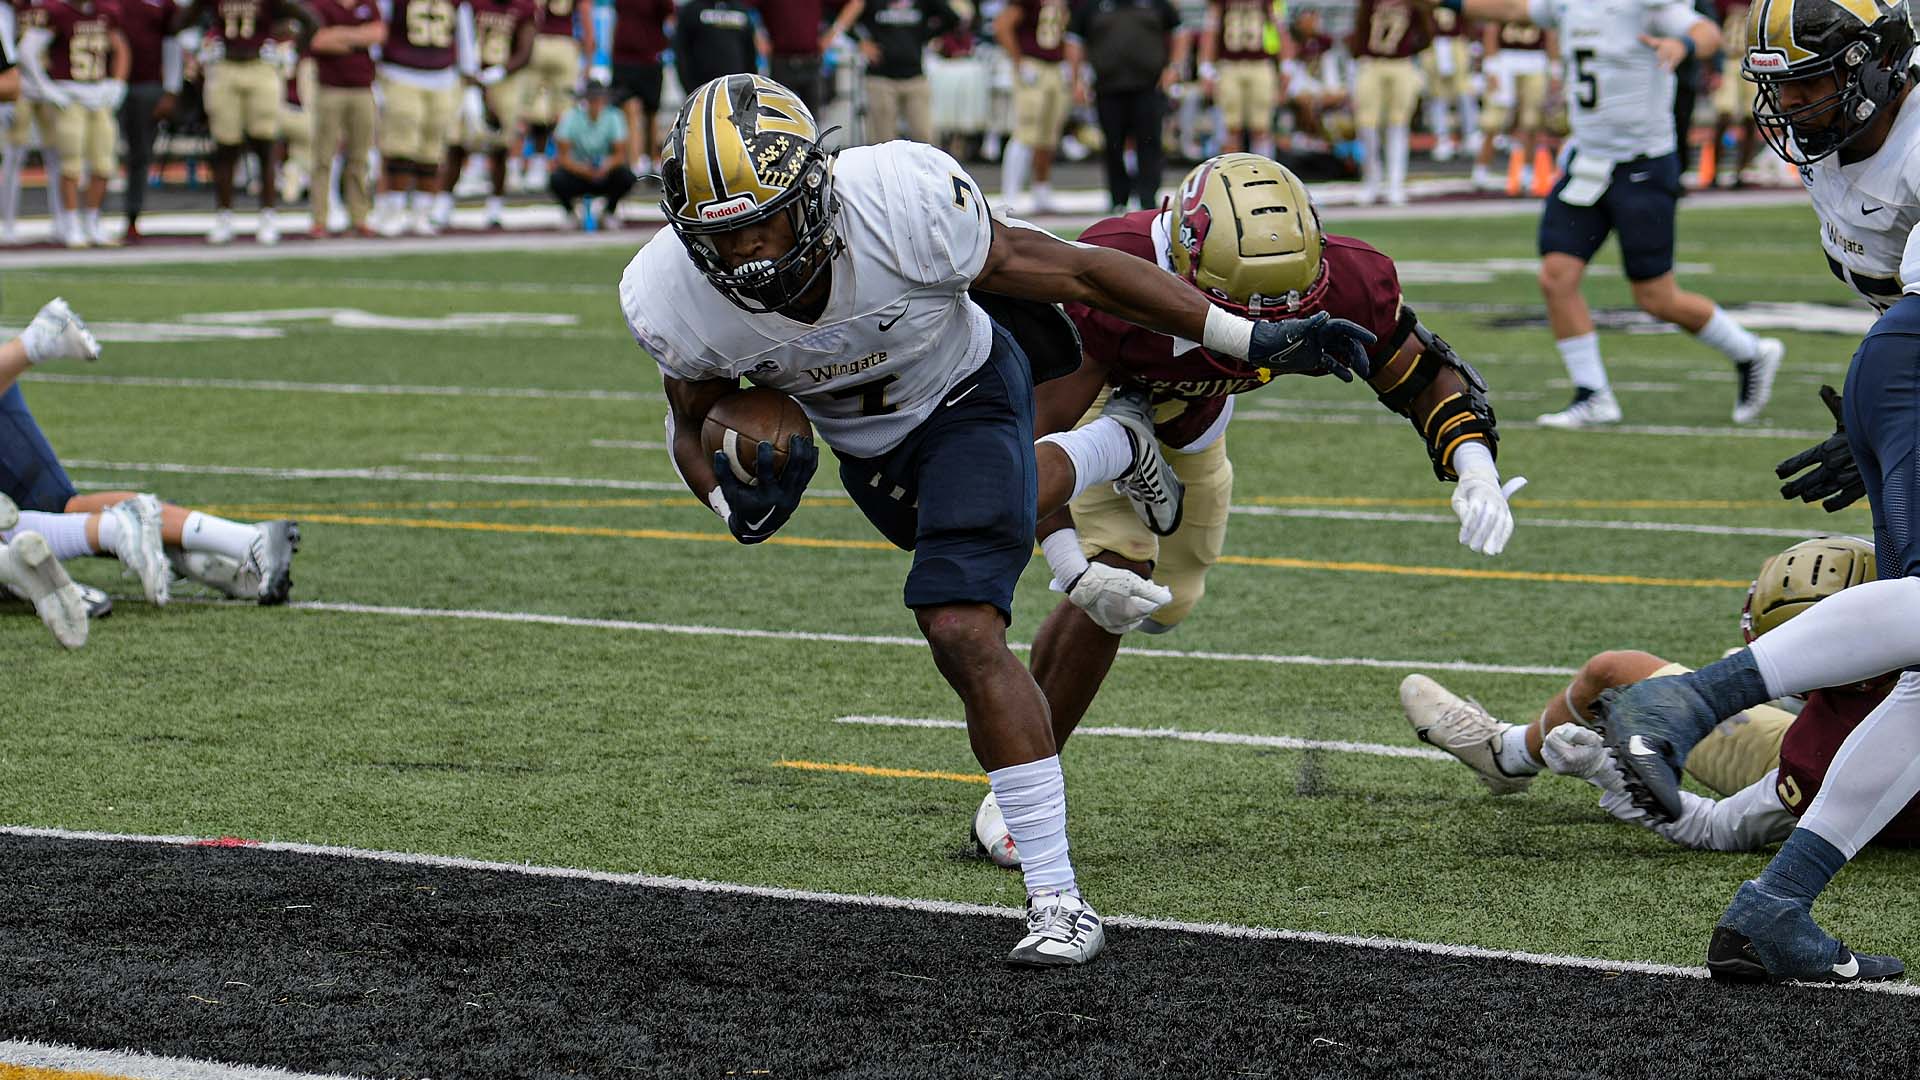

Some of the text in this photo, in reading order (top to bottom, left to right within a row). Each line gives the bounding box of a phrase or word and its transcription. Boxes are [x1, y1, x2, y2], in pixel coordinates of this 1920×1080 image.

[1573, 49, 1597, 109] 5
[704, 202, 747, 219] Riddell
[801, 351, 888, 383] Wingate
